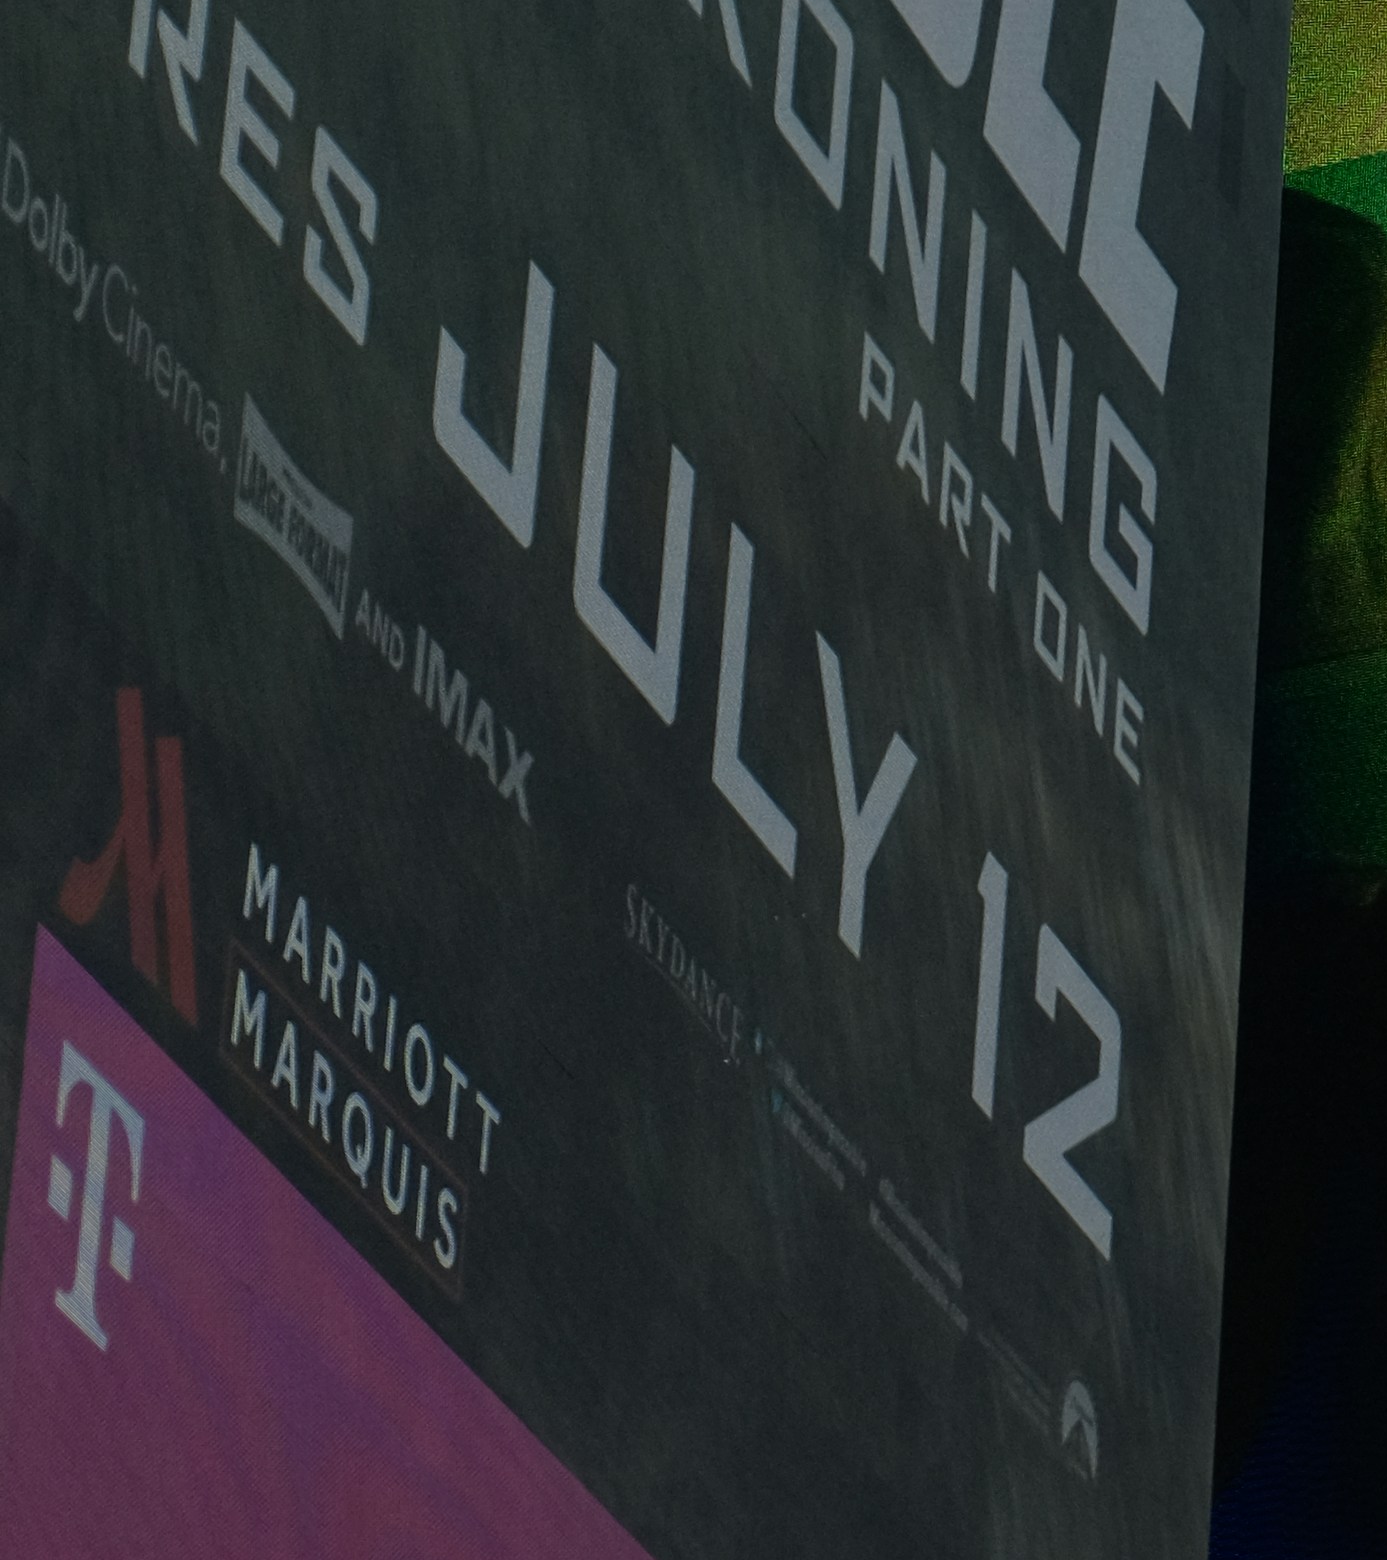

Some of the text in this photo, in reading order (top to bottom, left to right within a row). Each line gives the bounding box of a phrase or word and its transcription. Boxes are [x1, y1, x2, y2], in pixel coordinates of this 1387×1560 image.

[2, 137, 98, 321] Dolby
[102, 264, 226, 474] Cinema,
[355, 587, 405, 671] AND
[413, 623, 535, 826] IMAX
[860, 333, 1145, 785] PART ONE
[433, 260, 1122, 1261] JULY 12
[231, 970, 460, 1269] MARQUIS
[243, 842, 501, 1175] MARRIOTT
[626, 883, 744, 1061] SKYDANCE
